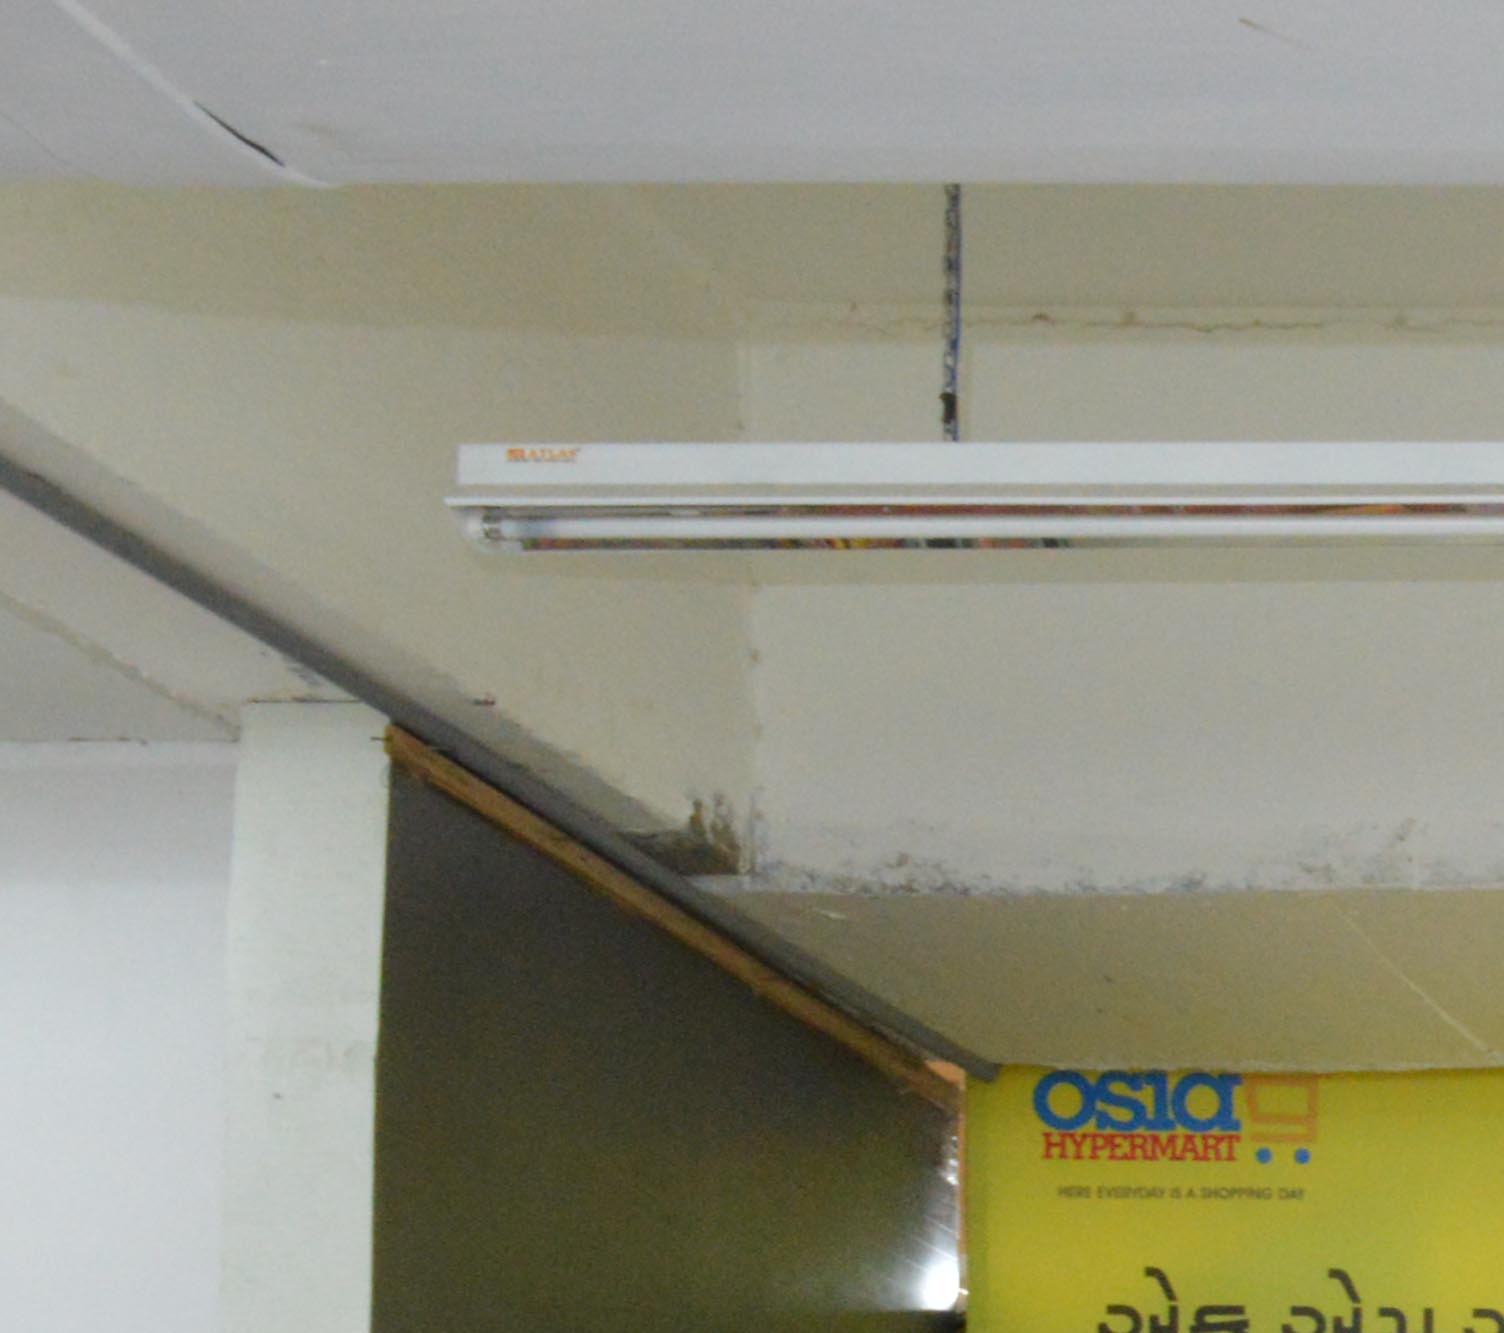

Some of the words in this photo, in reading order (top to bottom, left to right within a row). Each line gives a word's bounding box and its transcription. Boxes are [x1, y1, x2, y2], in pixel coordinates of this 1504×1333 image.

[1042, 1132, 1241, 1162] HYPERMART
[1058, 1187, 1091, 1198] HERE
[1098, 1187, 1165, 1198] EVERYDAY
[1170, 1188, 1181, 1198] IS
[1186, 1188, 1194, 1198] A
[1202, 1189, 1272, 1199] SHOPPING
[1279, 1189, 1304, 1199] DAY
